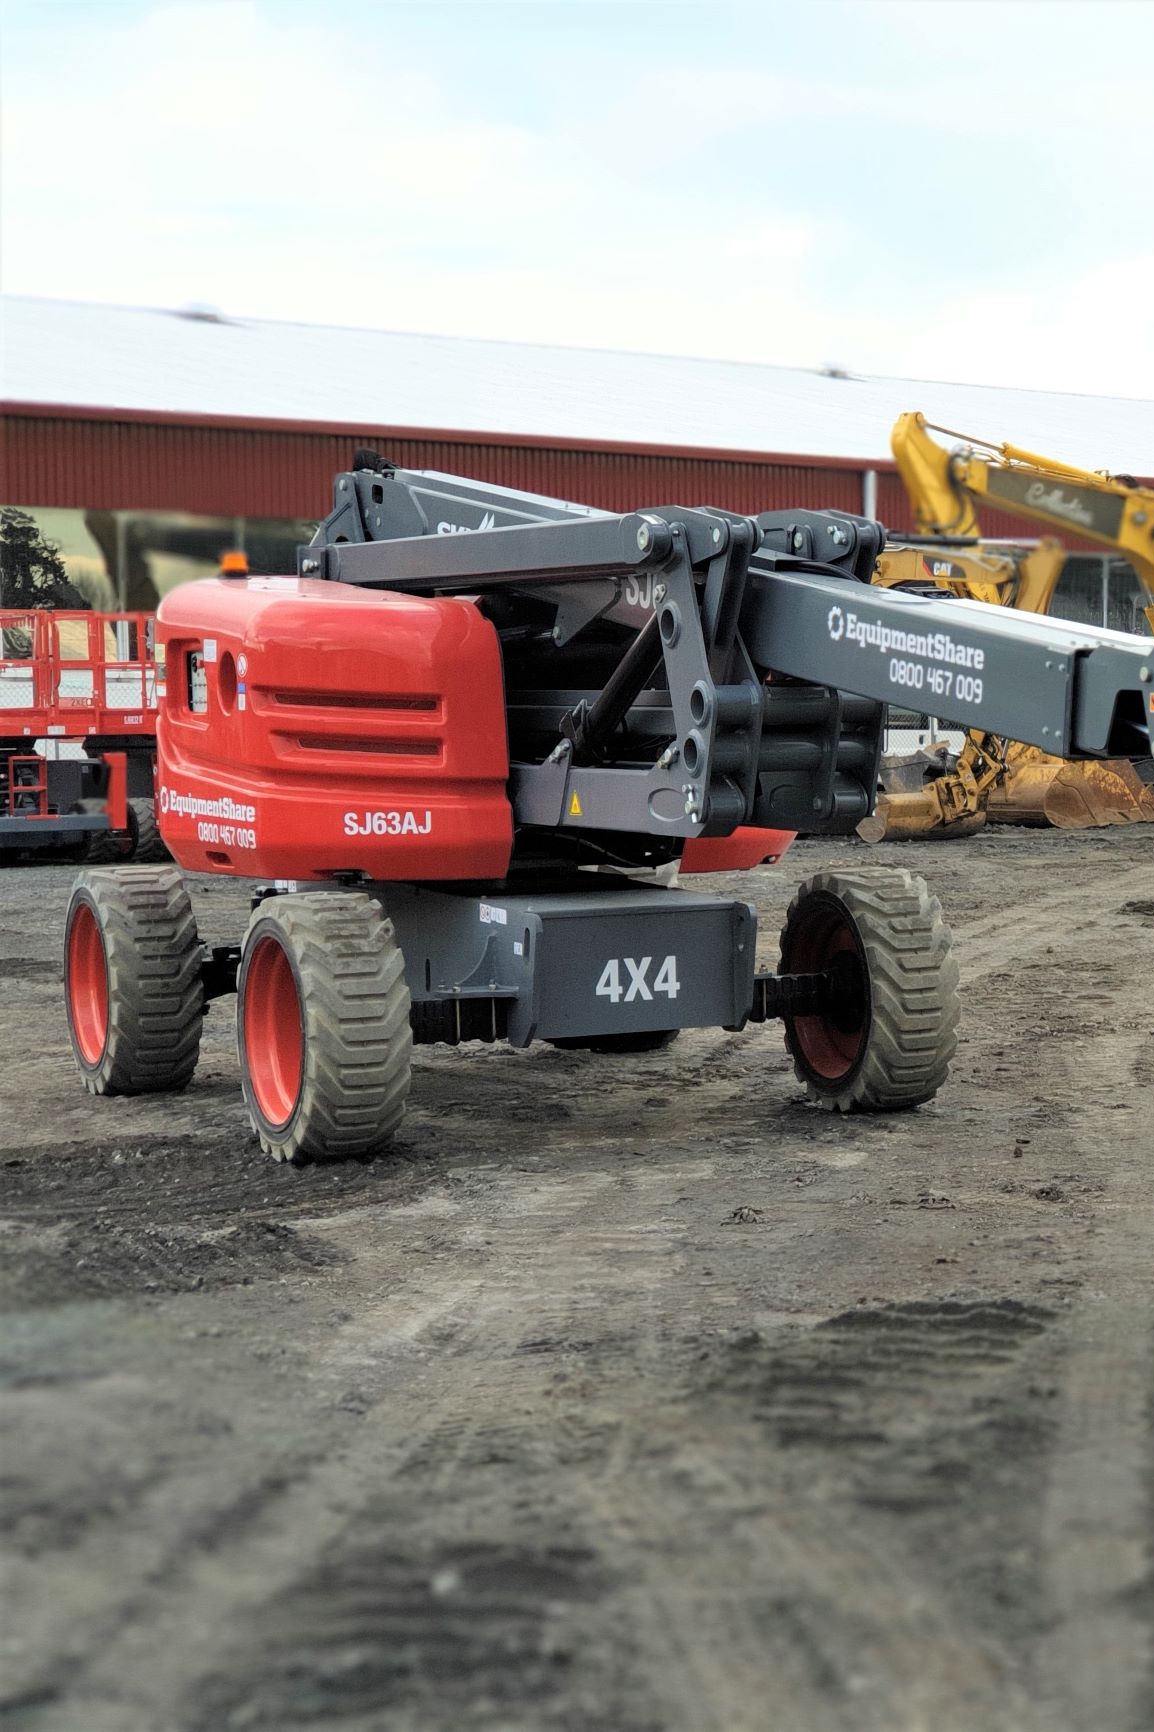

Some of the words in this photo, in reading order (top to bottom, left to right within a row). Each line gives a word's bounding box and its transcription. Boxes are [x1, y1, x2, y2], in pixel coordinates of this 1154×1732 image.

[933, 562, 952, 577] CAT
[625, 573, 658, 610] SJ
[846, 612, 985, 671] EquipmentShare
[889, 657, 924, 689] 0800
[926, 667, 953, 697] 467
[955, 674, 983, 704] 009
[169, 789, 256, 823] EquipmentShare
[343, 811, 432, 836] SJ63AJ
[198, 821, 220, 844] 0800
[220, 824, 236, 846] 467
[236, 827, 257, 850] 009
[595, 954, 681, 1003] 4X4
